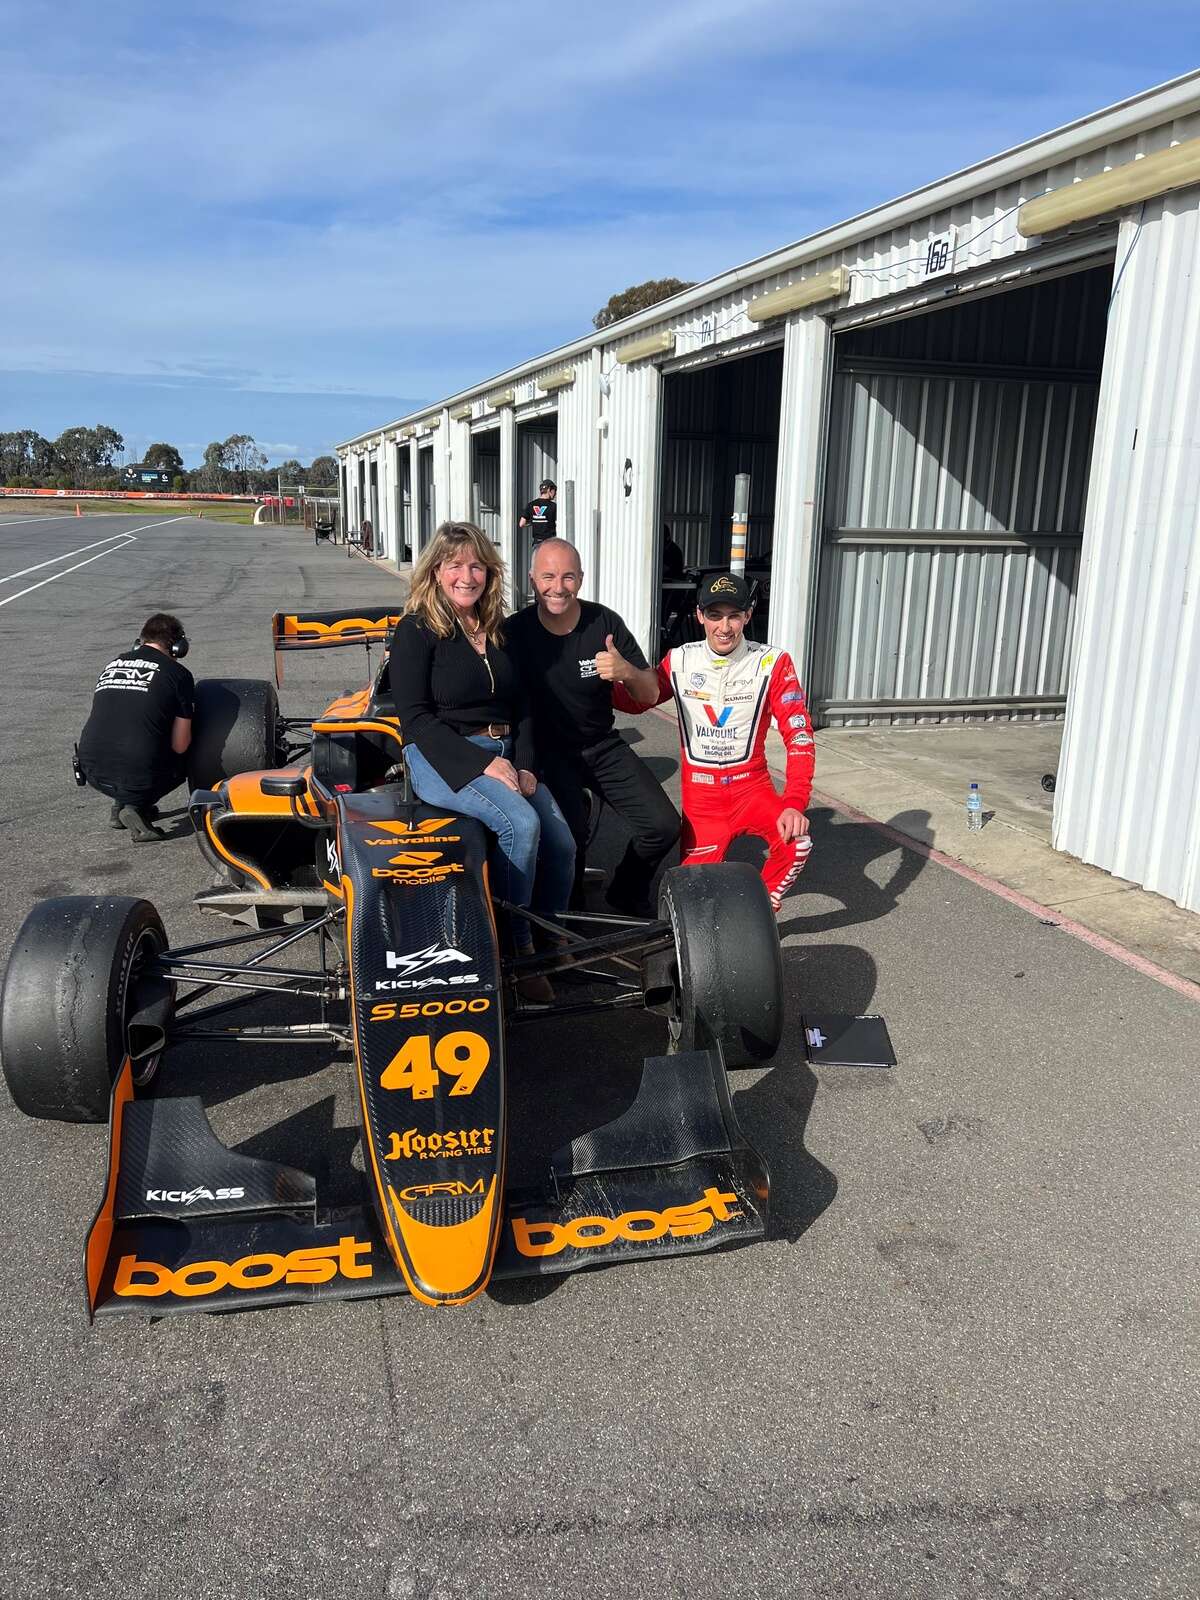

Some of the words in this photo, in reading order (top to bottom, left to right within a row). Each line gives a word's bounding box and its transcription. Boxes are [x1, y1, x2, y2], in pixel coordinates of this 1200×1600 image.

[696, 724, 738, 739] VALVOLINE
[364, 836, 461, 846] Valvoline
[371, 862, 464, 878] boost
[392, 875, 446, 886] mobile
[375, 974, 480, 990] KICKASS
[369, 998, 490, 1022] S5000
[380, 1031, 491, 1100] 49
[384, 1128, 495, 1160] Hoosier
[420, 1150, 463, 1159] RACING
[464, 1146, 493, 1155] TIRE
[146, 1186, 245, 1206] KICKASS
[512, 1187, 743, 1257] boost
[113, 1236, 373, 1297] boost
